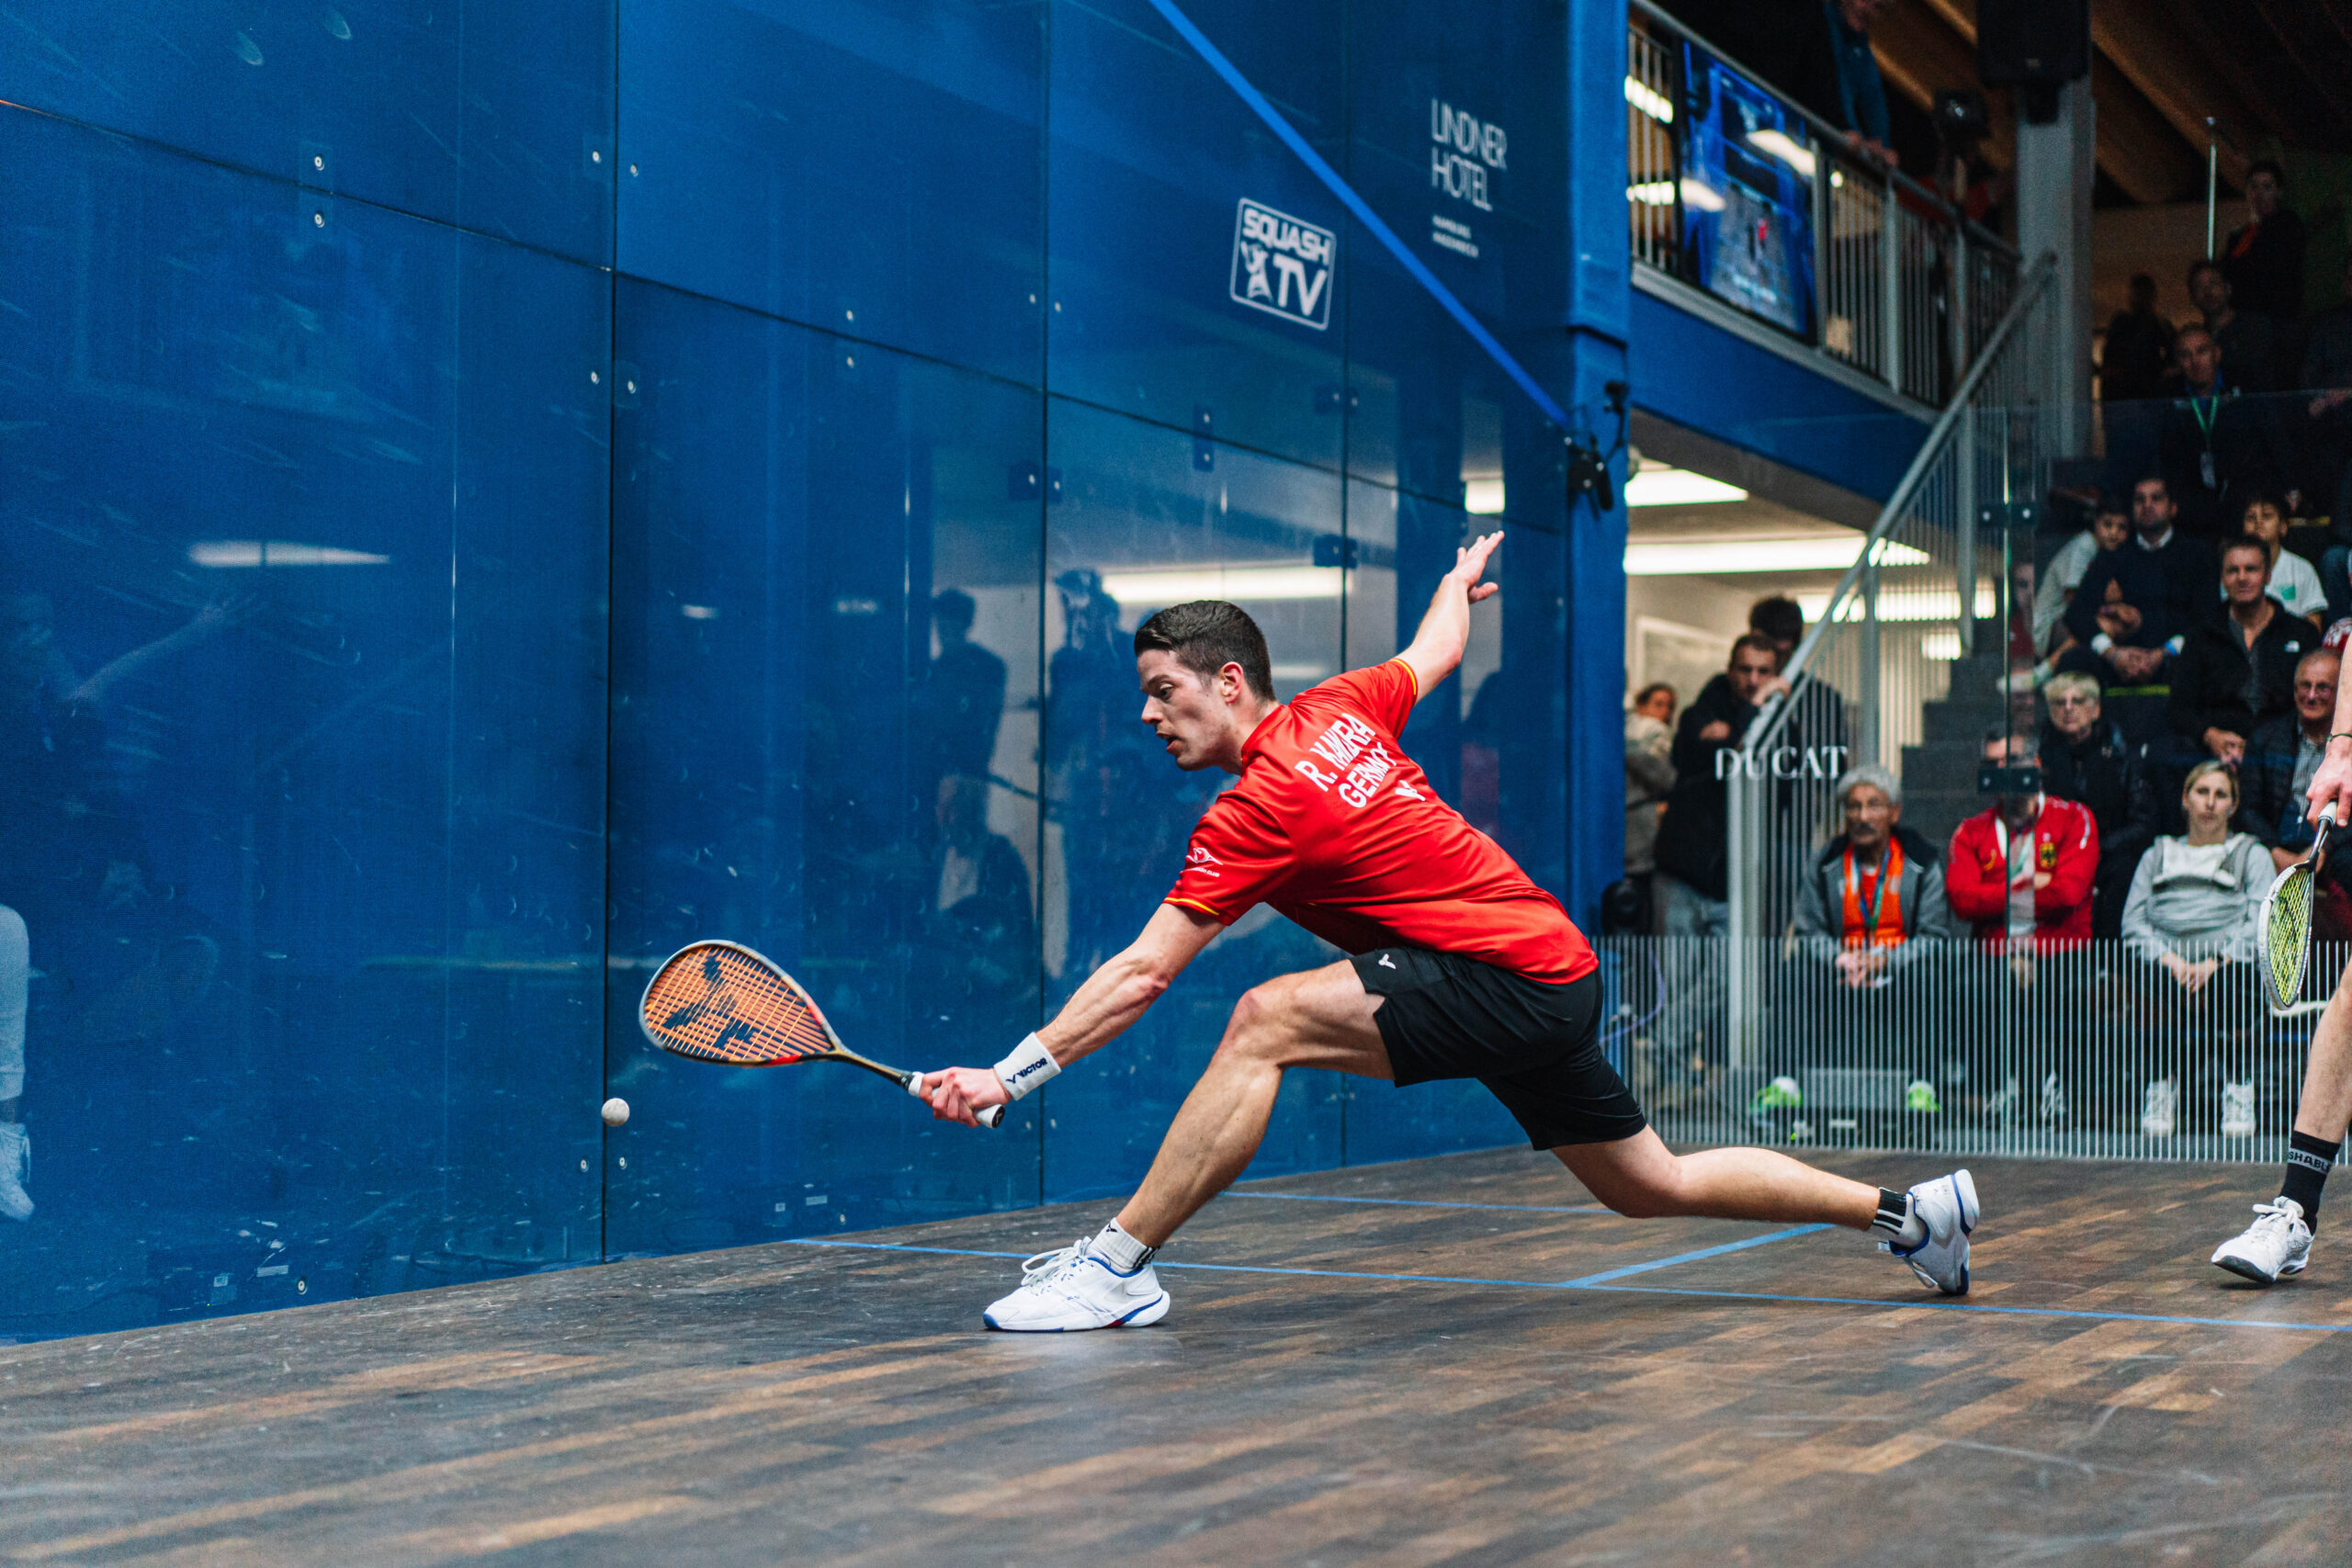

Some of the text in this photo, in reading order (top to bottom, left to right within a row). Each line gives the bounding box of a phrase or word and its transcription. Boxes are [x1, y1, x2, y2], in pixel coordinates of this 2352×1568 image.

[1431, 97, 1508, 170] LINDNER
[1431, 147, 1493, 211] HOTEL
[1242, 208, 1330, 266] SQUASH
[1273, 254, 1328, 317] TV
[1294, 761, 1339, 793] R.
[1715, 746, 1849, 780] DUCAT
[1016, 1057, 1048, 1077] VICTOR
